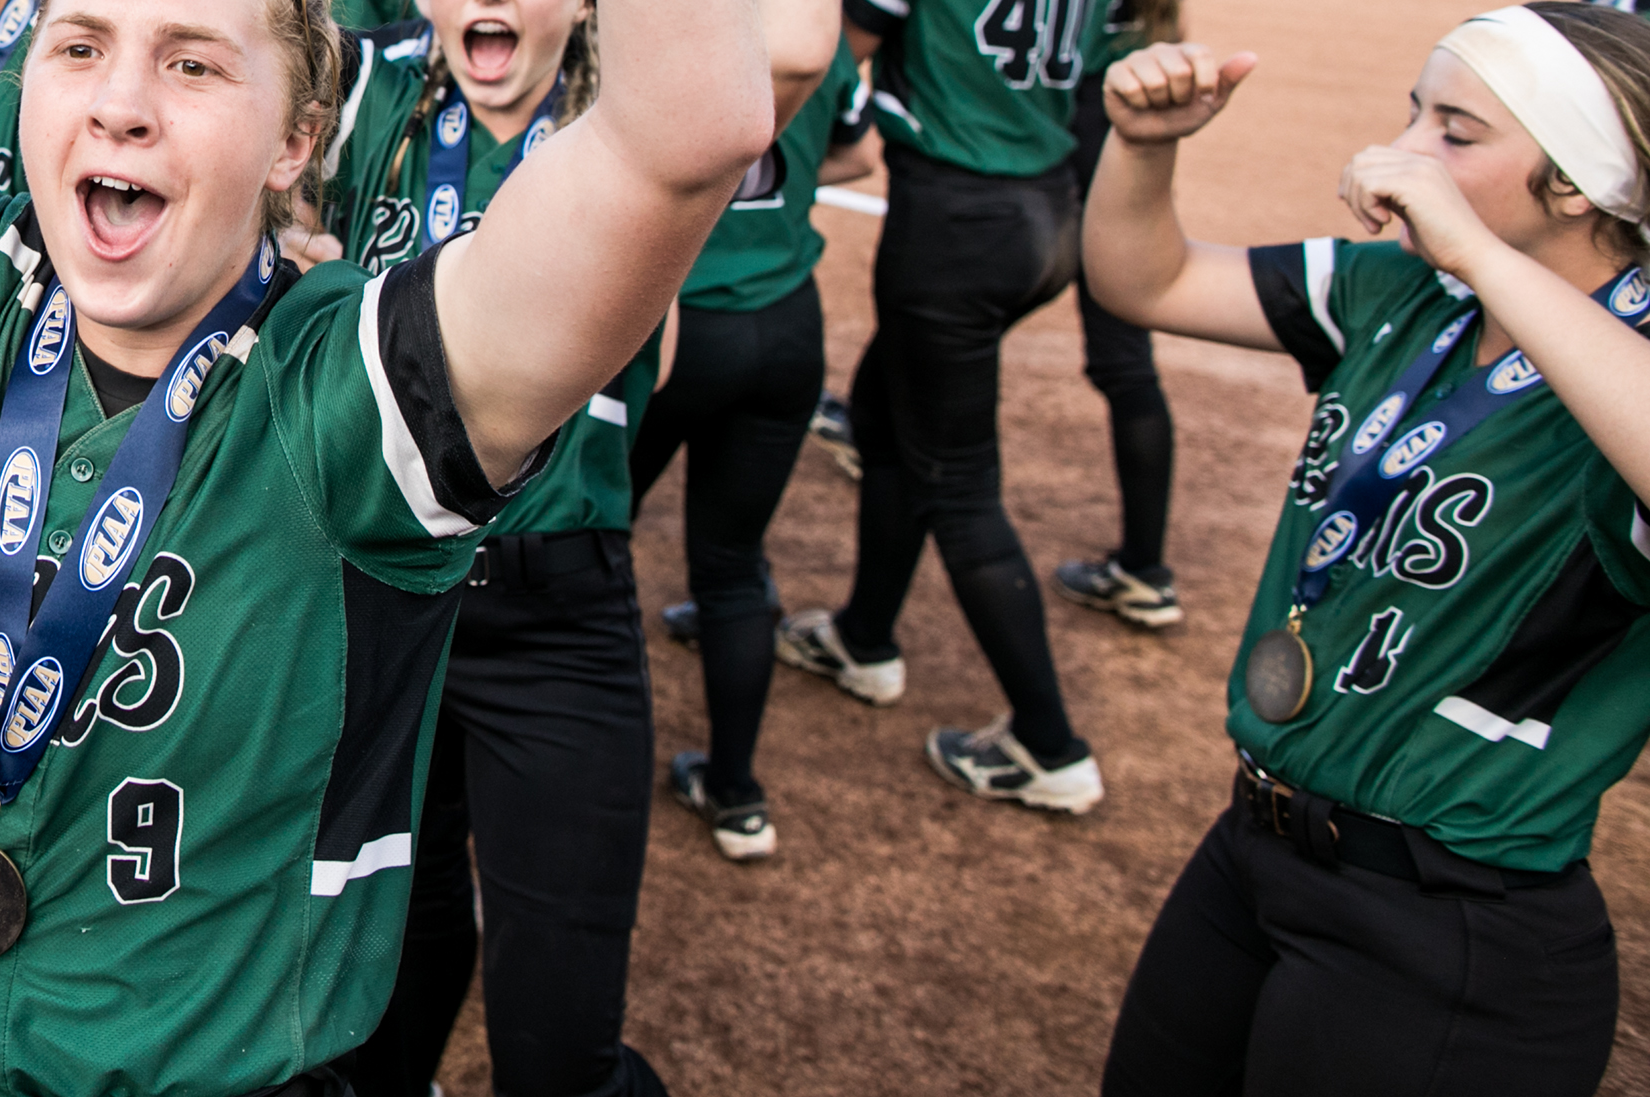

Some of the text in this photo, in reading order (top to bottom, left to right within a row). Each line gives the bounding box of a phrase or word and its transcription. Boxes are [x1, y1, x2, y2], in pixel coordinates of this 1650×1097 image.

[31, 294, 69, 368] PIAA
[172, 335, 227, 413] PIAA
[0, 456, 35, 546] PIAA
[86, 494, 141, 582] PIAA
[7, 664, 62, 744] PIAA
[107, 776, 185, 905] 9
